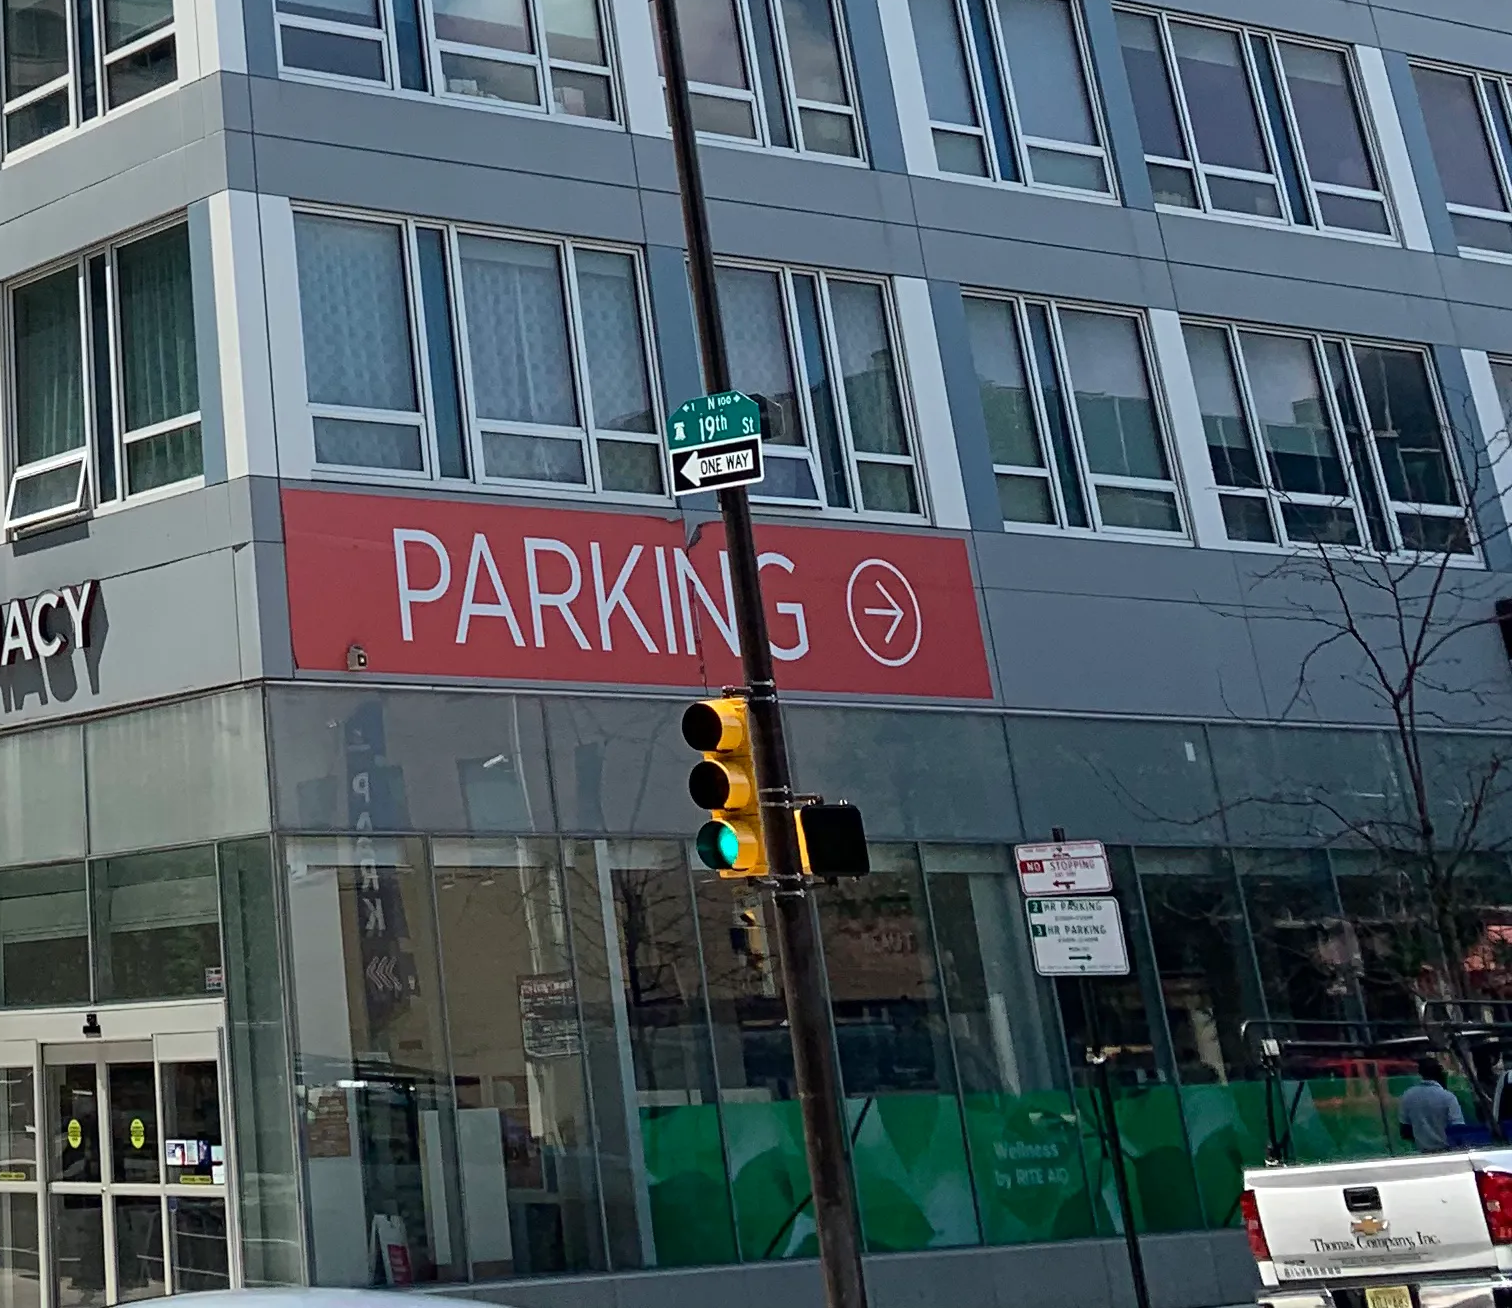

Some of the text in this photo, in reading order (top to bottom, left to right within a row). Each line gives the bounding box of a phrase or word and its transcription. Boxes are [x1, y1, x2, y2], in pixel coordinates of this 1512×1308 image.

[691, 395, 732, 412] 1 N 100
[699, 414, 755, 442] 19th St
[700, 451, 750, 475] ONE WAY
[392, 527, 811, 662] PARKING
[1026, 859, 1096, 872] NO STOPPING
[1043, 902, 1056, 912] HR
[1061, 901, 1103, 912] PARKING
[1048, 925, 1060, 935] HR
[1065, 924, 1107, 935] PARKING
[993, 1141, 1059, 1160] Wellness
[994, 1168, 1011, 1190] by
[1015, 1167, 1044, 1184] RITE
[1309, 1231, 1442, 1253] Thomas Company, Inc.
